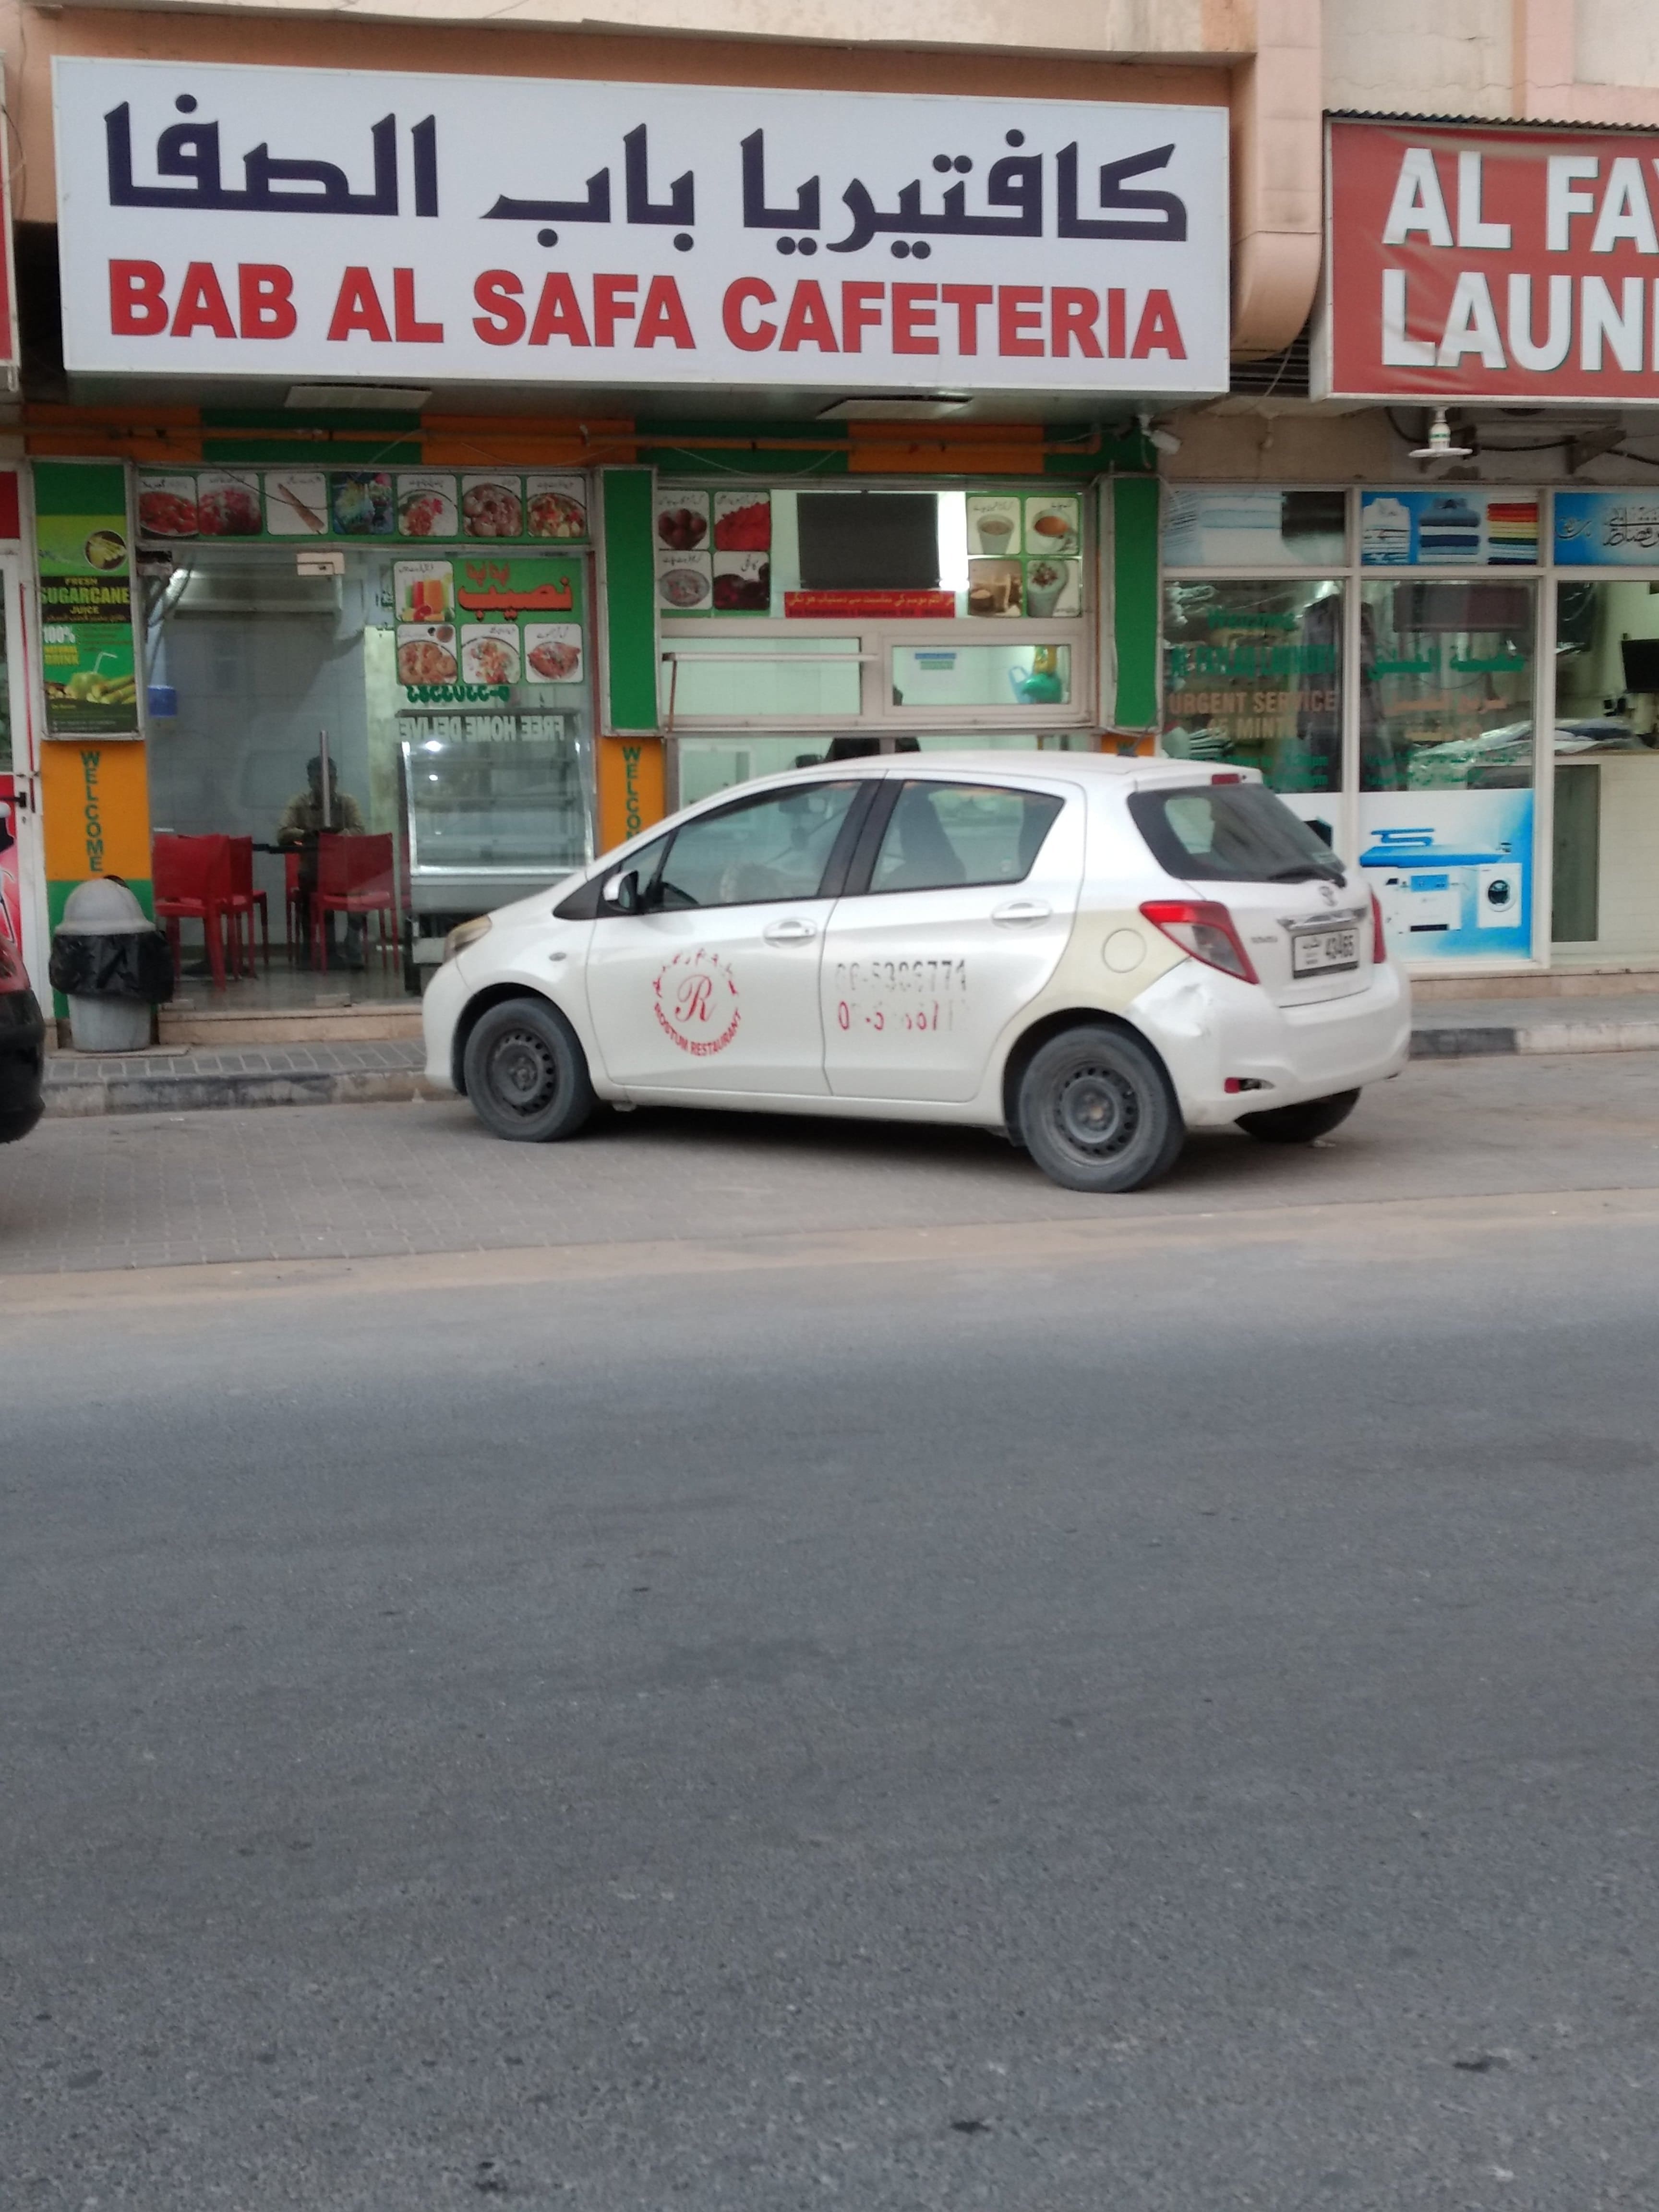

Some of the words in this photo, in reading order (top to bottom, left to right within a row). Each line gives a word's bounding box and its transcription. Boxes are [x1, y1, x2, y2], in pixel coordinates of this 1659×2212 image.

[103, 93, 439, 218] الصفا
[480, 123, 695, 252] باب
[741, 128, 1188, 260] كافتيريا
[1382, 147, 1511, 249] AL
[1545, 155, 1659, 254] FA
[108, 258, 298, 340] BAB
[326, 265, 445, 343] AL
[472, 268, 696, 350] SAFA
[722, 276, 1188, 360] CAFETERIA
[40, 587, 130, 604] SUGARCANE
[1168, 691, 1247, 714] URGENT
[1253, 690, 1336, 714] SERVICE
[80, 751, 104, 872] WELCOME
